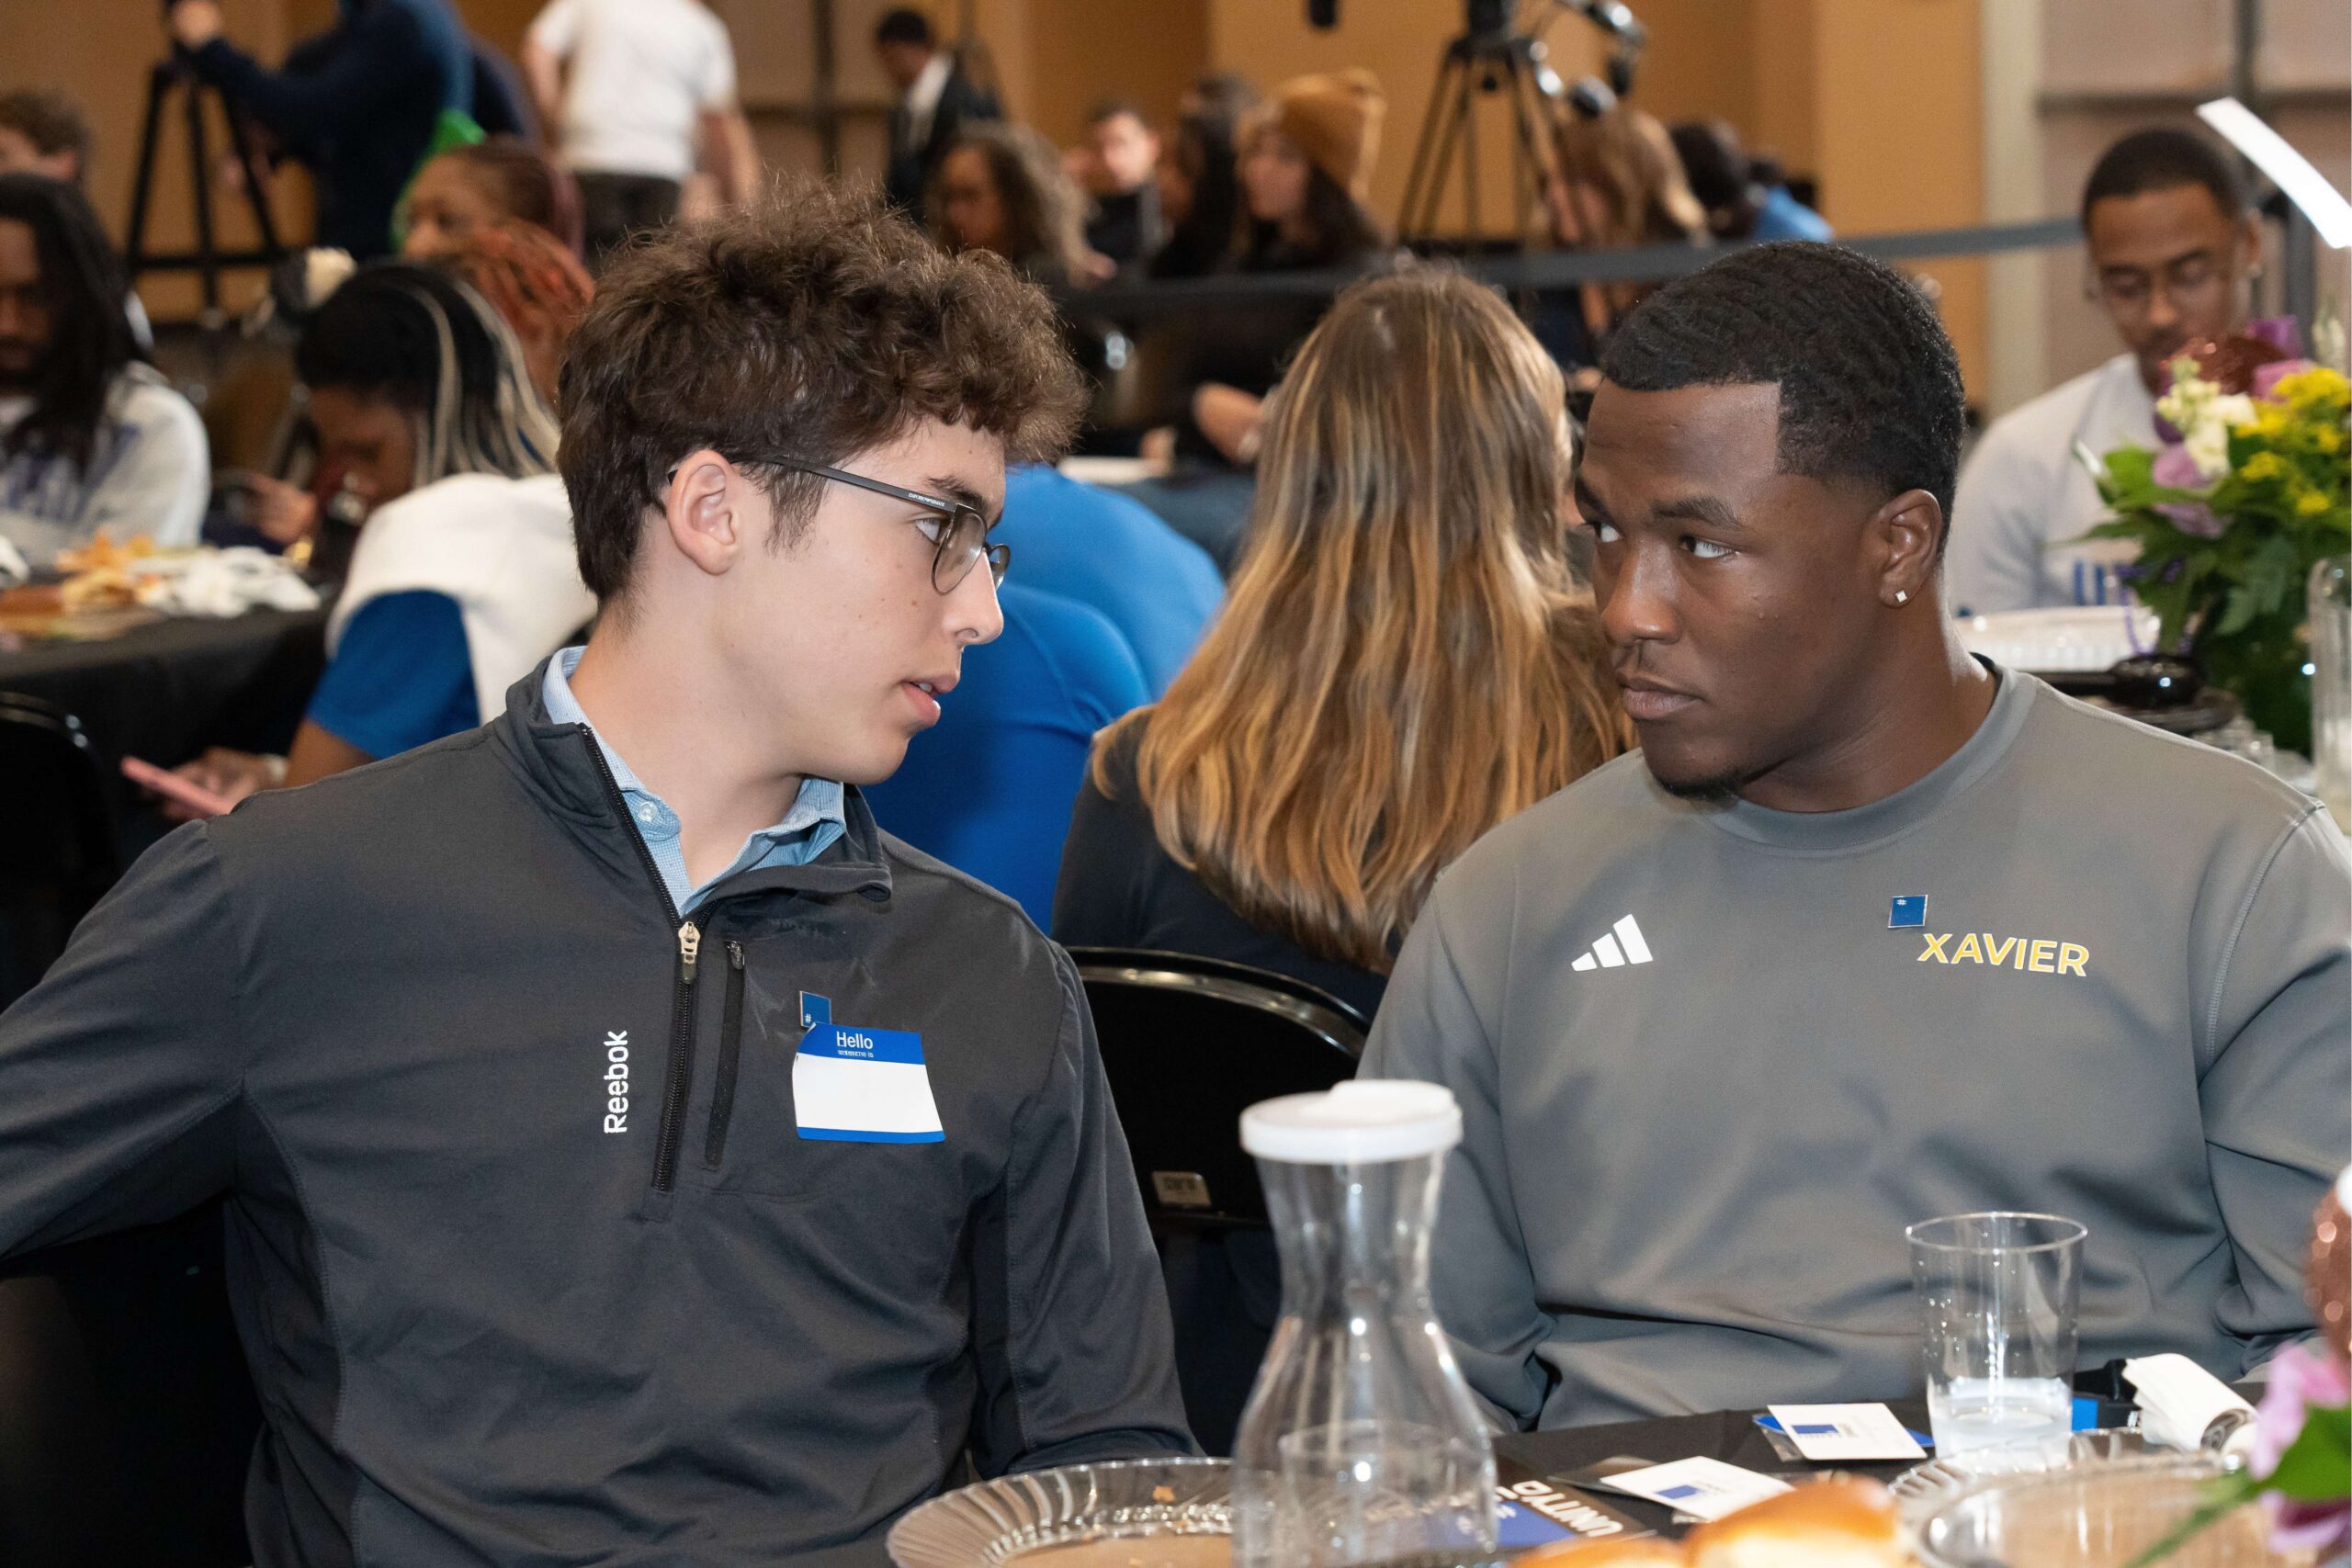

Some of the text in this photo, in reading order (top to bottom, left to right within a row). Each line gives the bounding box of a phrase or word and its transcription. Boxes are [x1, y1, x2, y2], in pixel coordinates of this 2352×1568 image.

[1917, 932, 2090, 977] XAVIER
[836, 1030, 874, 1049] Hello
[603, 1030, 629, 1134] Reebok
[1521, 1493, 1623, 1538] UNITY
